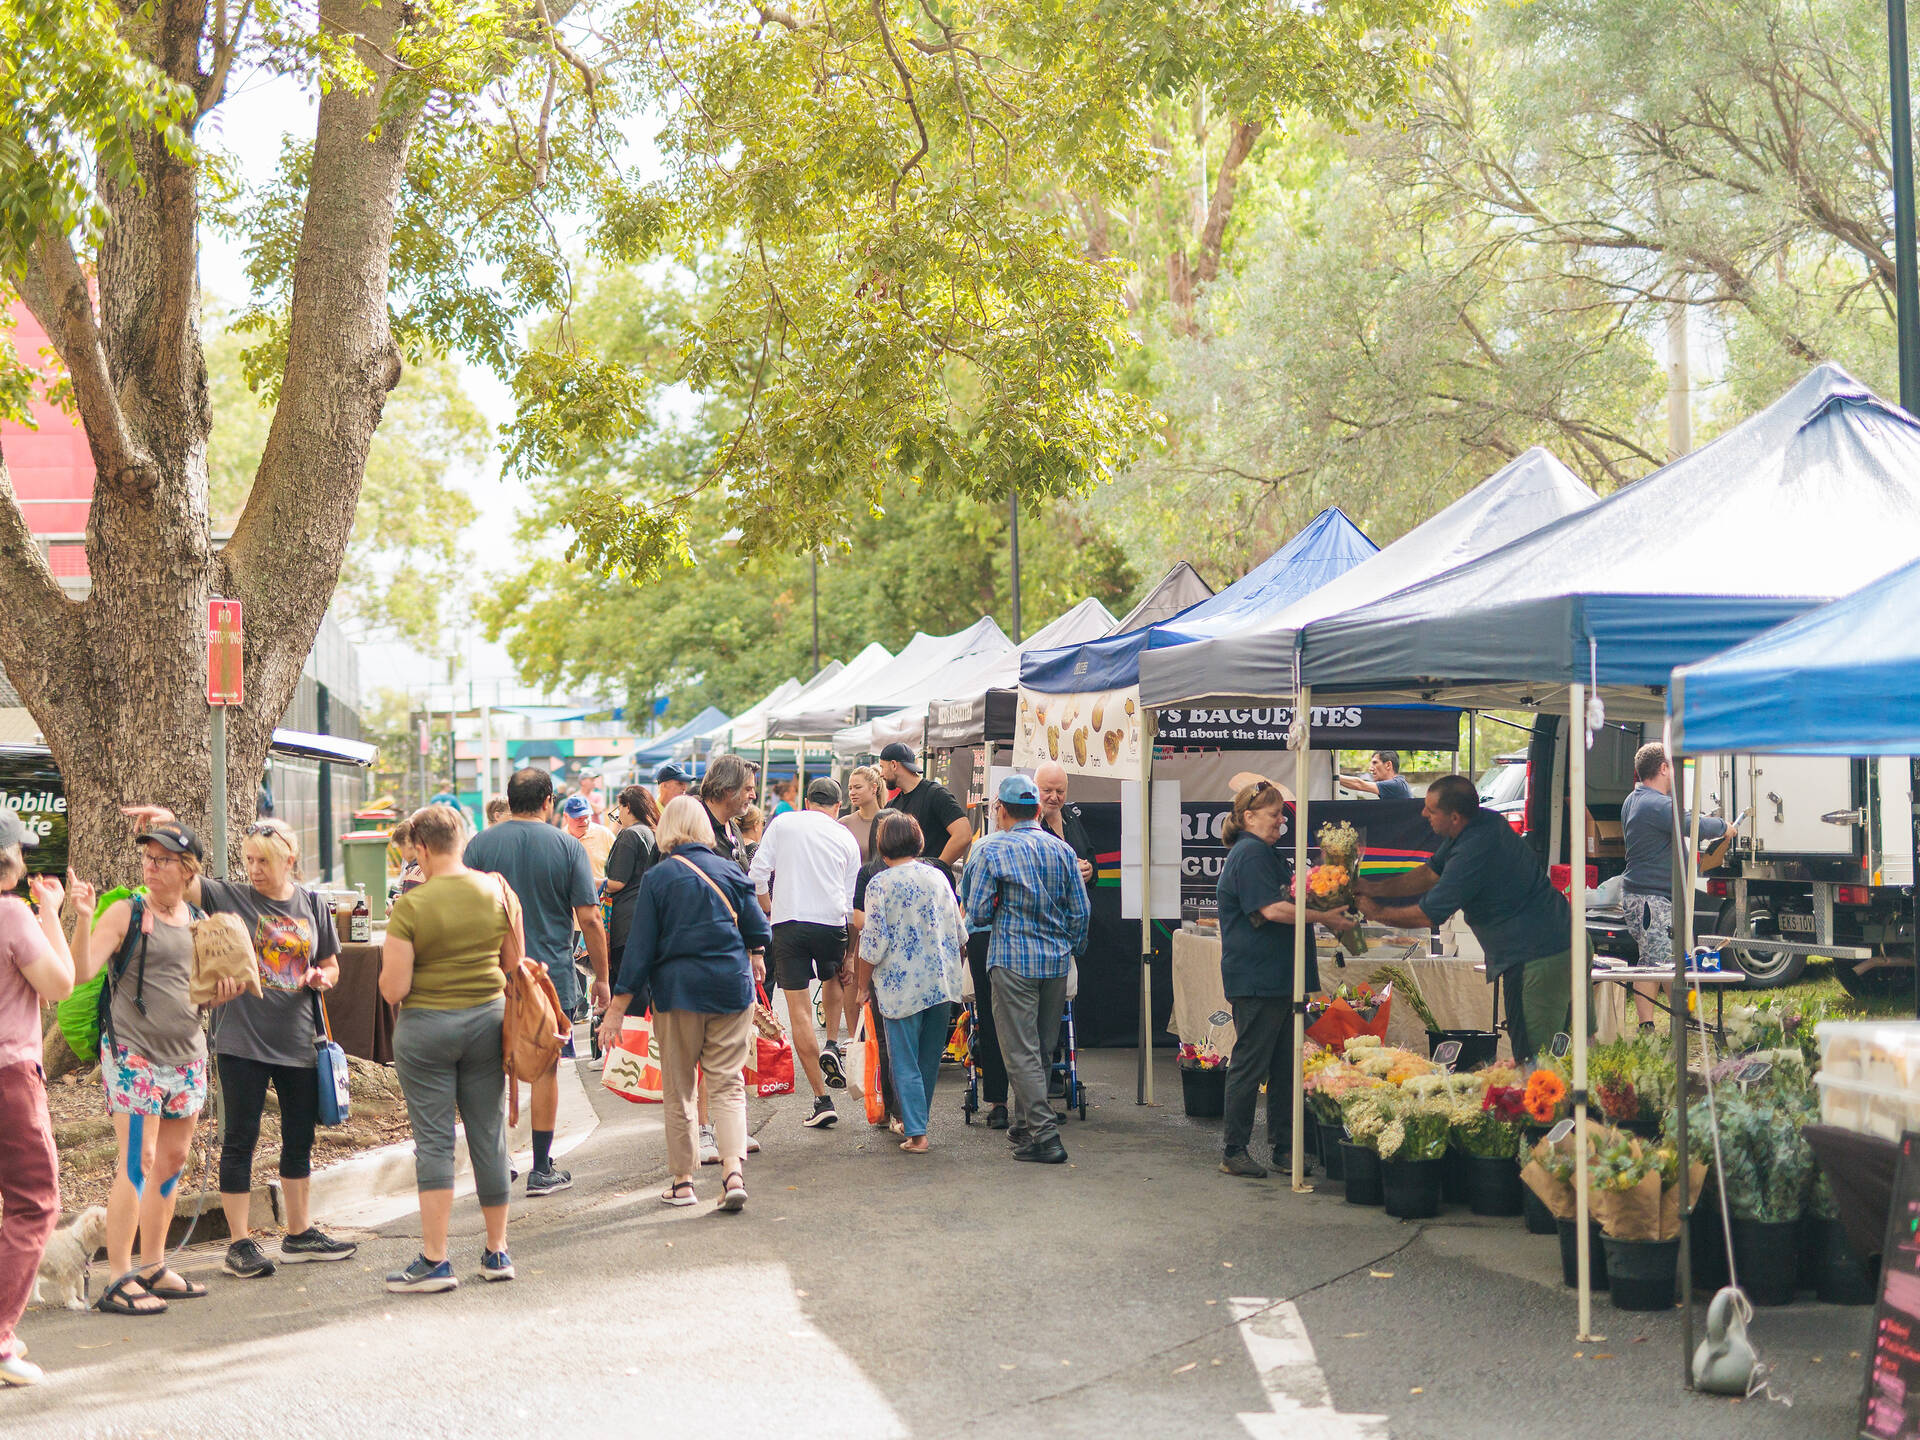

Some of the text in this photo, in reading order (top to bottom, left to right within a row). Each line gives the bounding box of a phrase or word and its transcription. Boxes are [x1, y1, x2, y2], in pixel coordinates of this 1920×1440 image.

[218, 609, 232, 624] NO
[209, 630, 241, 645] STOPPING
[1169, 728, 1188, 738] all
[1190, 728, 1230, 739] about
[1232, 729, 1255, 740] the
[1257, 729, 1290, 740] flavo
[1199, 897, 1218, 906] abo
[761, 1081, 790, 1093] coles
